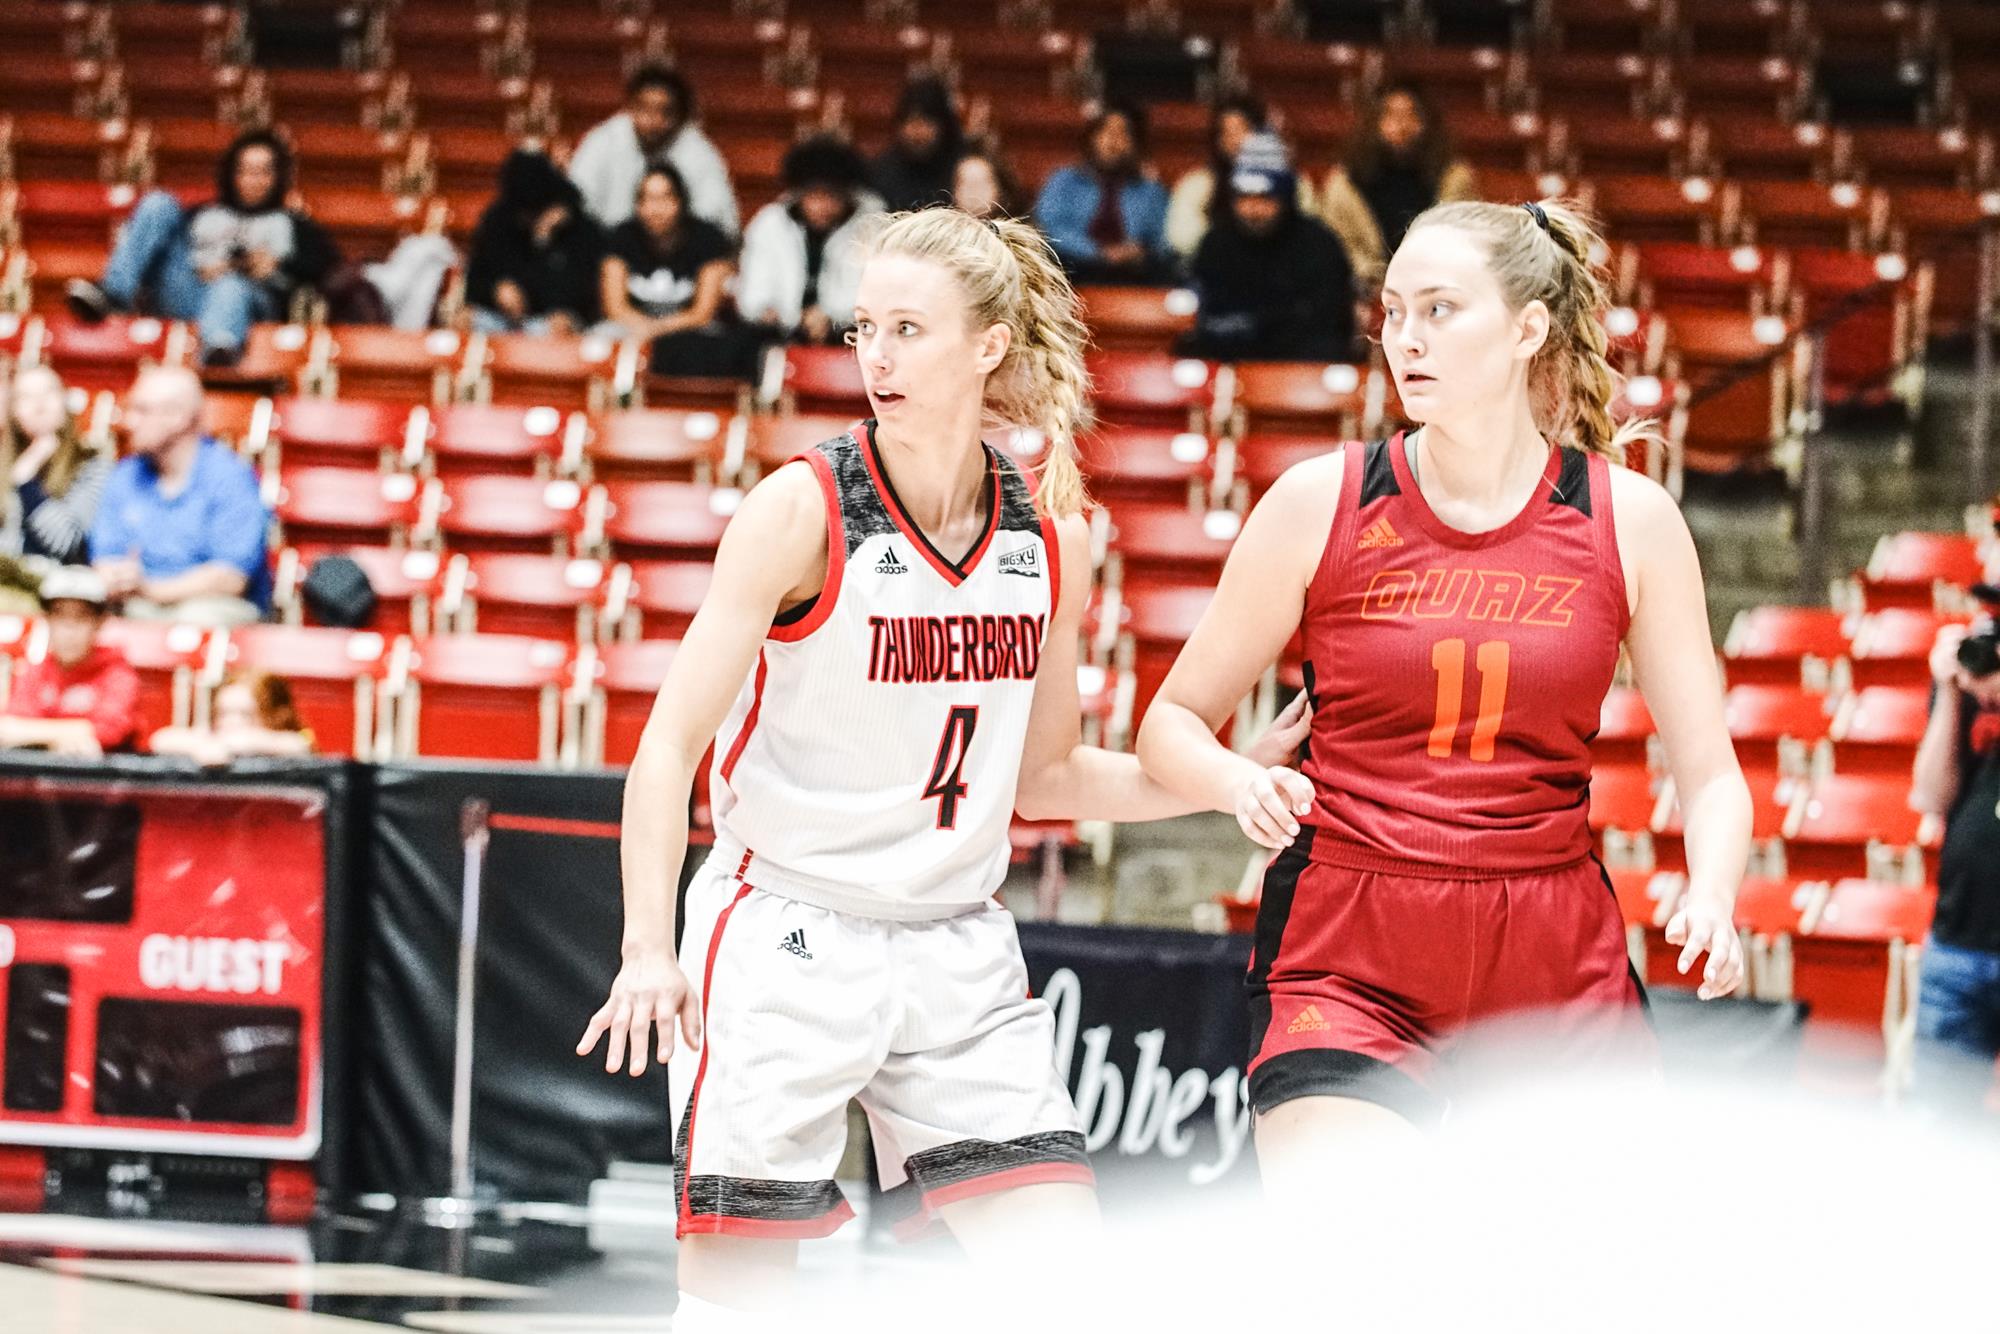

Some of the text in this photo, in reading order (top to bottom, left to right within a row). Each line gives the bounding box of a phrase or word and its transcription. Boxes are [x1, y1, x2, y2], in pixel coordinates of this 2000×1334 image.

[874, 563, 908, 574] addas
[1358, 535, 1404, 549] adidas
[868, 613, 1045, 683] THUNDERBIRD
[1427, 638, 1510, 762] 11
[921, 705, 979, 830] 4
[139, 933, 289, 994] GUEST
[1287, 1020, 1331, 1034] adidas
